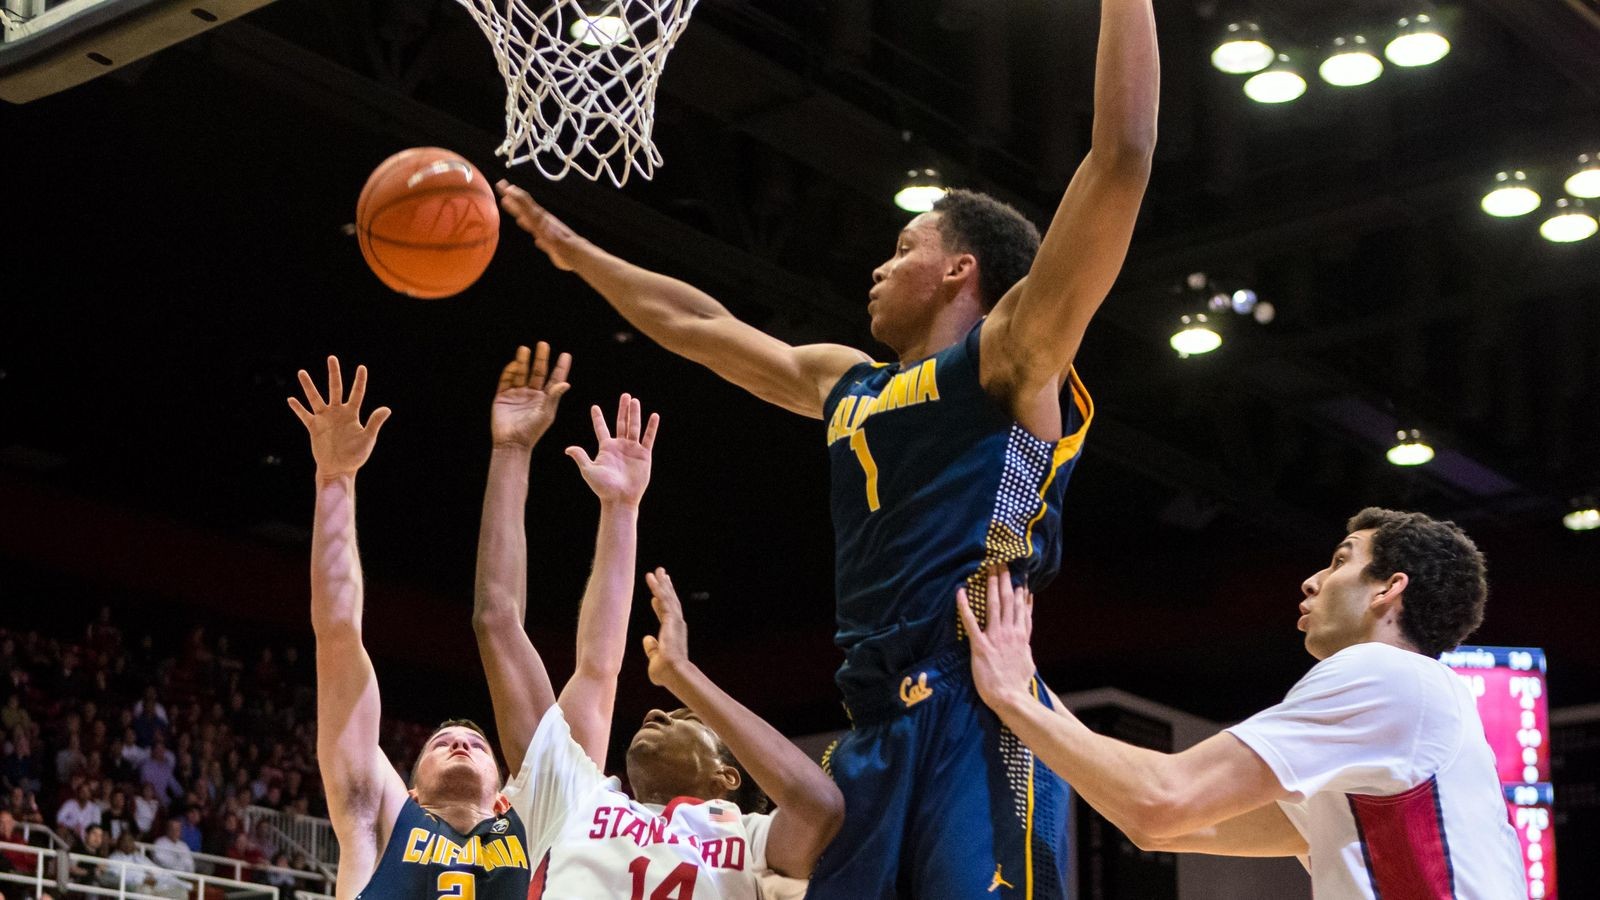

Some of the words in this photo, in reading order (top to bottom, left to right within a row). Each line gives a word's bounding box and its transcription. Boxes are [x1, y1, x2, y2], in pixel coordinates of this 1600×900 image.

[851, 427, 880, 512] 1
[589, 807, 745, 871] STANRD
[628, 856, 698, 900] 14
